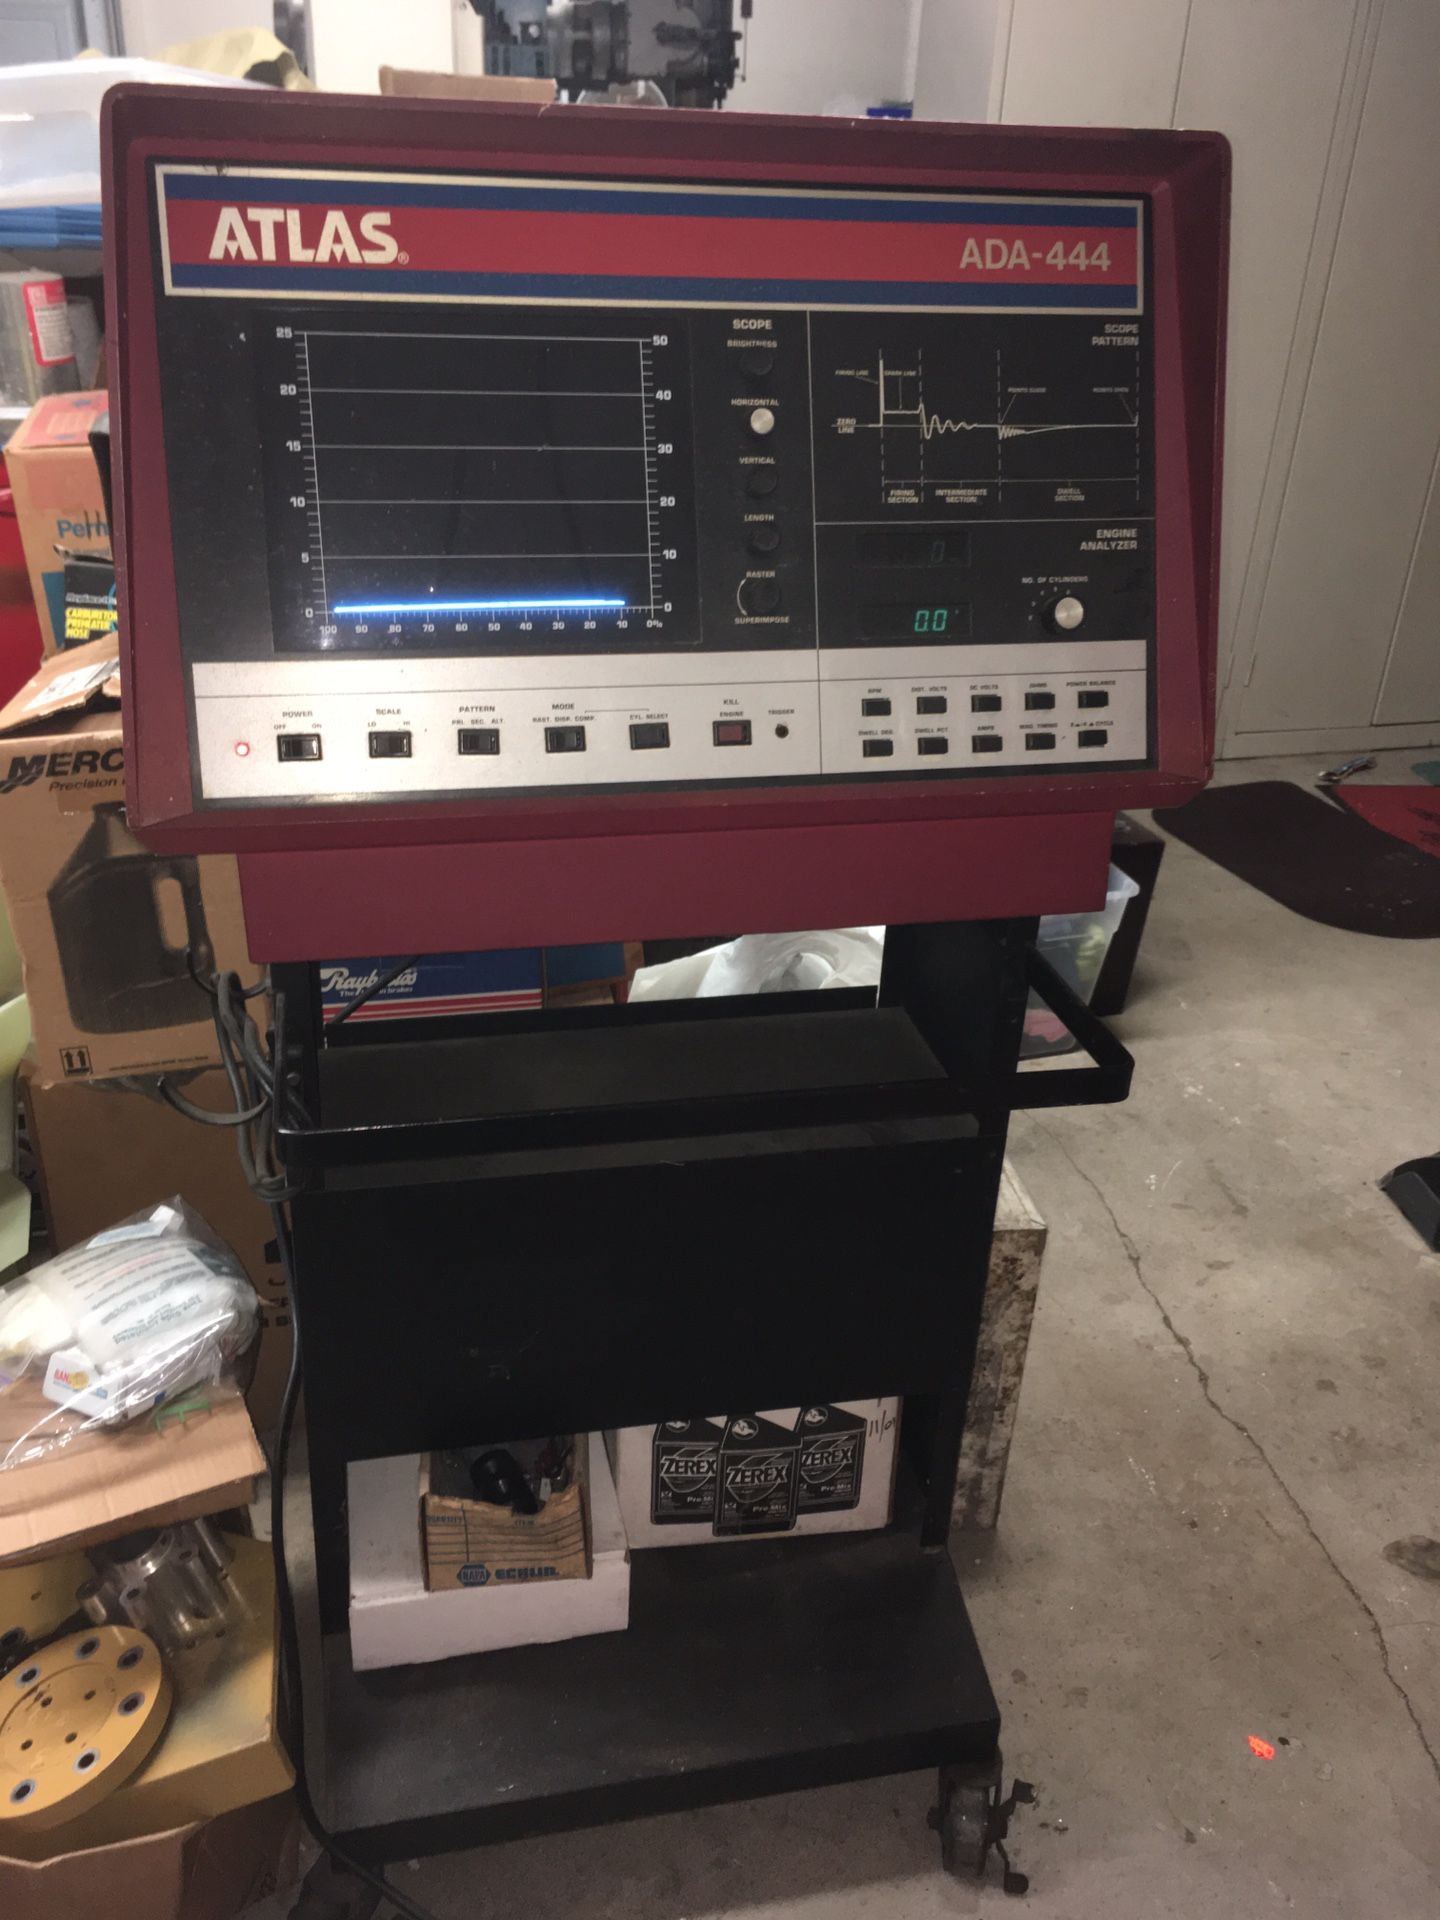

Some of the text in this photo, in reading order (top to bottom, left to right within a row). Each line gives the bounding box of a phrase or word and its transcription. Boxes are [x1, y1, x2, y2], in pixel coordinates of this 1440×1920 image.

[208, 206, 398, 264] ATLAS
[959, 237, 1112, 271] ADA-444
[732, 318, 773, 330] SCOPE
[1104, 323, 1139, 334] SCOPE
[275, 326, 293, 339] 25
[652, 335, 668, 346] 50
[1091, 335, 1139, 346] PATTERN
[279, 384, 297, 396] 20
[656, 390, 672, 401] 40
[731, 398, 780, 407] HORIZONTAL
[837, 417, 856, 425] ZERO
[286, 440, 301, 452] 15
[657, 443, 673, 454] 30
[739, 456, 776, 465] VERTICAL
[290, 496, 306, 508] 10
[660, 496, 676, 507] 20
[744, 514, 775, 522] LENGTH
[1096, 528, 1137, 538] ENGINE
[1079, 540, 1137, 551] ANALYZER
[301, 552, 310, 563] 5
[663, 549, 677, 560] 10
[746, 570, 776, 578] RASTER
[305, 607, 314, 618] 0
[664, 602, 672, 612] 0
[734, 615, 790, 625] SUPERIMPOSE
[422, 623, 435, 633] 70
[519, 621, 533, 631] 40
[616, 620, 628, 629] 10
[646, 619, 664, 629] 0%
[376, 708, 402, 716] SCALE
[458, 704, 496, 713] PATTERN
[552, 703, 575, 711] MODE
[282, 710, 313, 718] POWER
[48, 779, 117, 792] Precision
[727, 1465, 787, 1487] ZEREX
